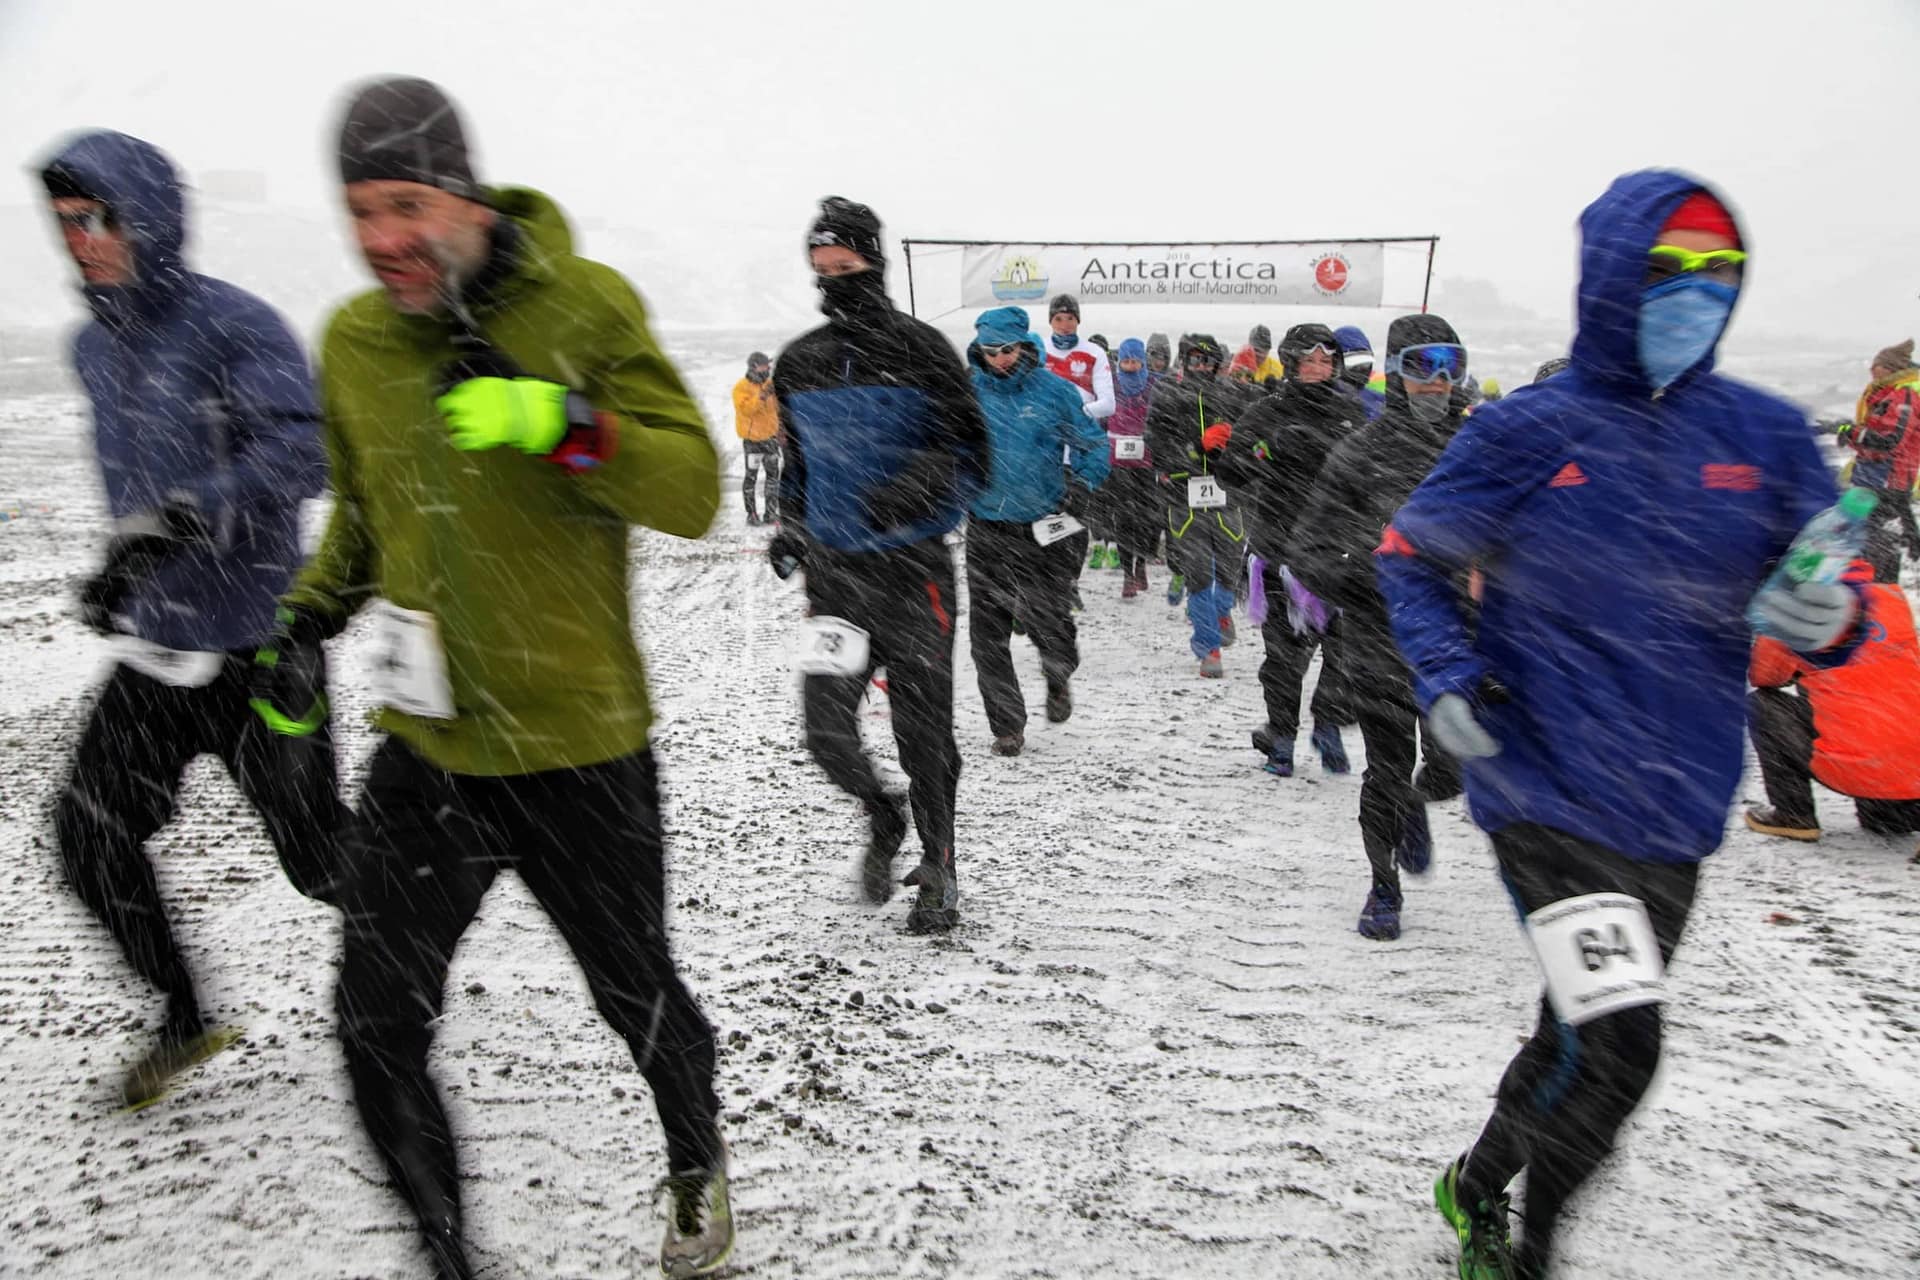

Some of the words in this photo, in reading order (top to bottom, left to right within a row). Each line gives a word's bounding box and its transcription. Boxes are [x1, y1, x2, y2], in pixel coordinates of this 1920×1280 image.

[1081, 257, 1276, 279] Antarctica
[1080, 281, 1152, 295] Marathon
[1156, 281, 1167, 294] &
[1172, 280, 1278, 295] Half-Marathon
[1200, 484, 1214, 498] 21
[1573, 922, 1638, 974] 64
